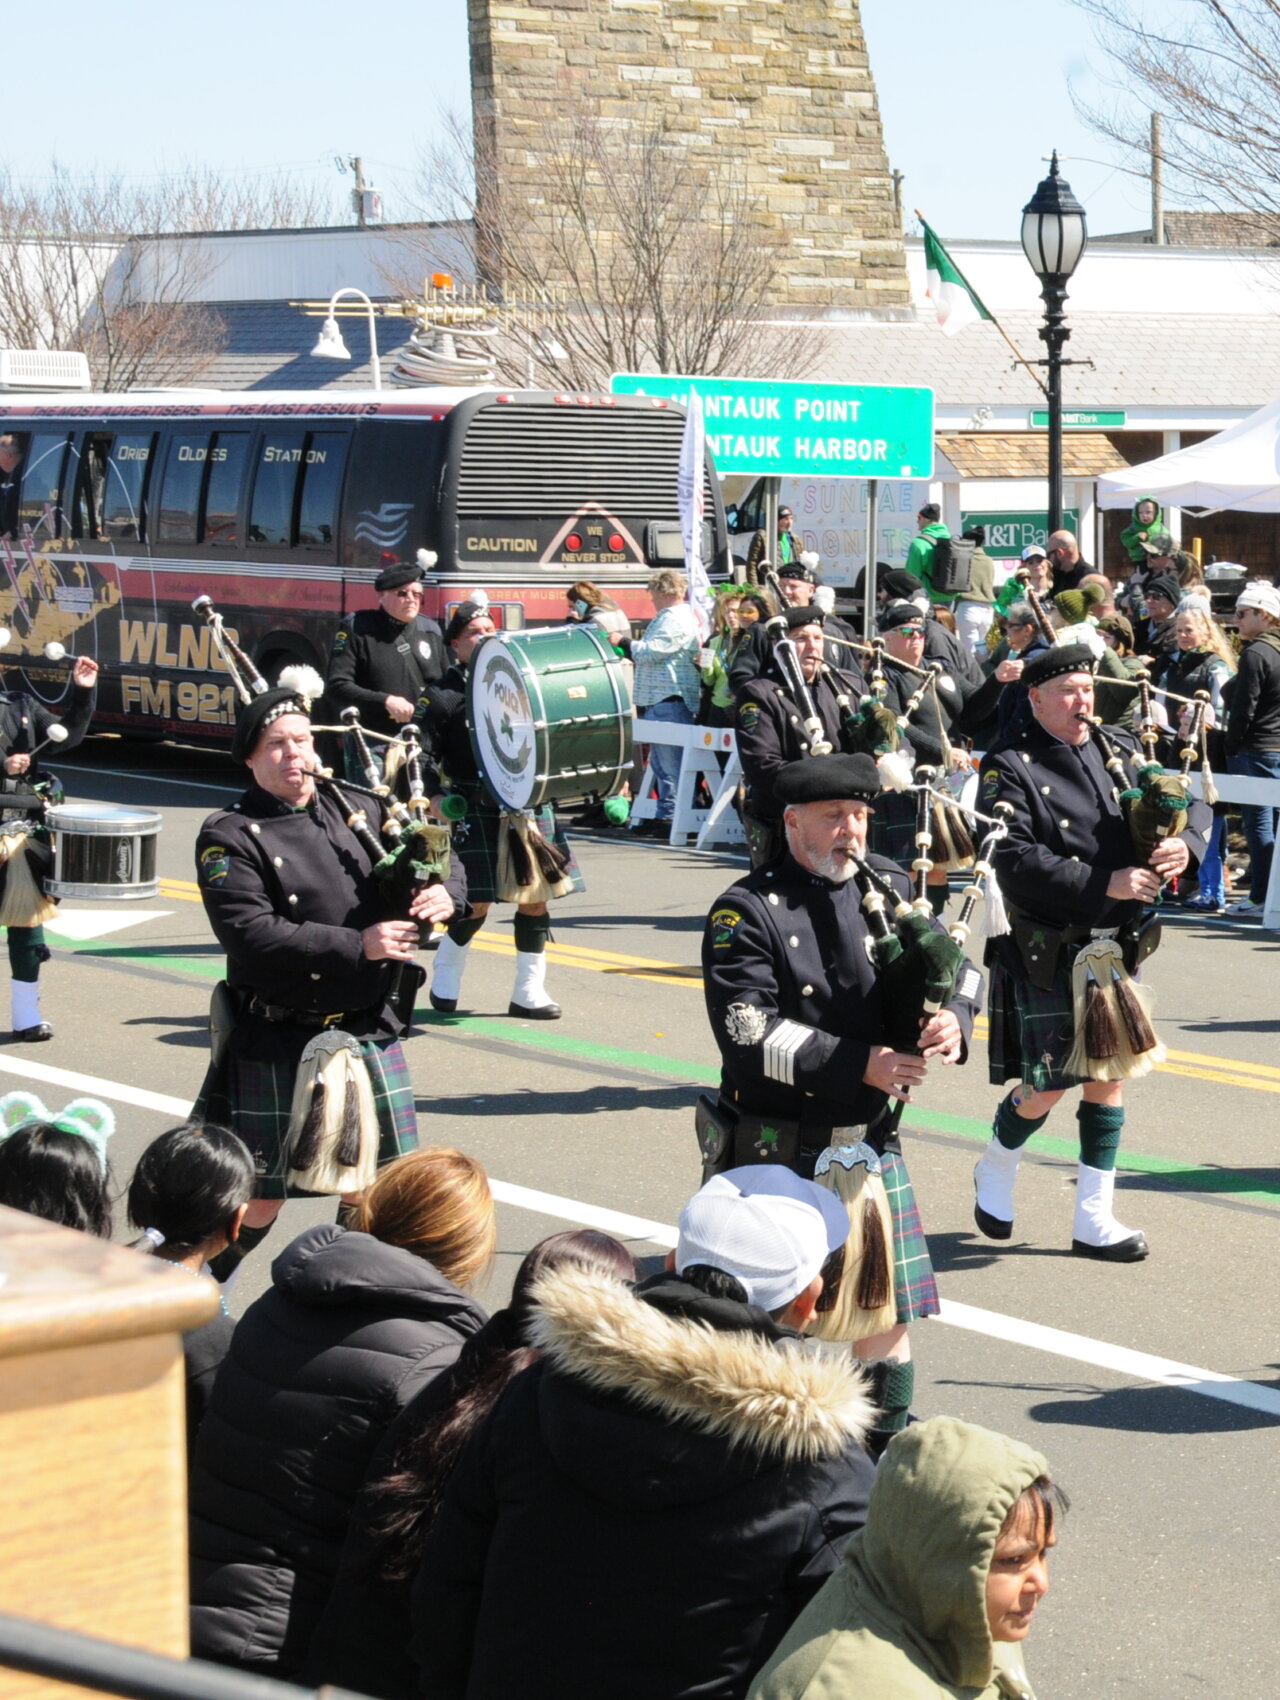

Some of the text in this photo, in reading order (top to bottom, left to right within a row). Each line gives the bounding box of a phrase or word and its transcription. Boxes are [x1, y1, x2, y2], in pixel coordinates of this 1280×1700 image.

[305, 402, 381, 415] RESULTS
[795, 398, 861, 421] POINT
[795, 436, 888, 461] HARBOR
[586, 526, 604, 536] WE
[466, 537, 537, 552] CAUTION
[561, 553, 627, 563] NEVER STOP
[121, 675, 172, 719] FM
[494, 682, 519, 715] POLICE
